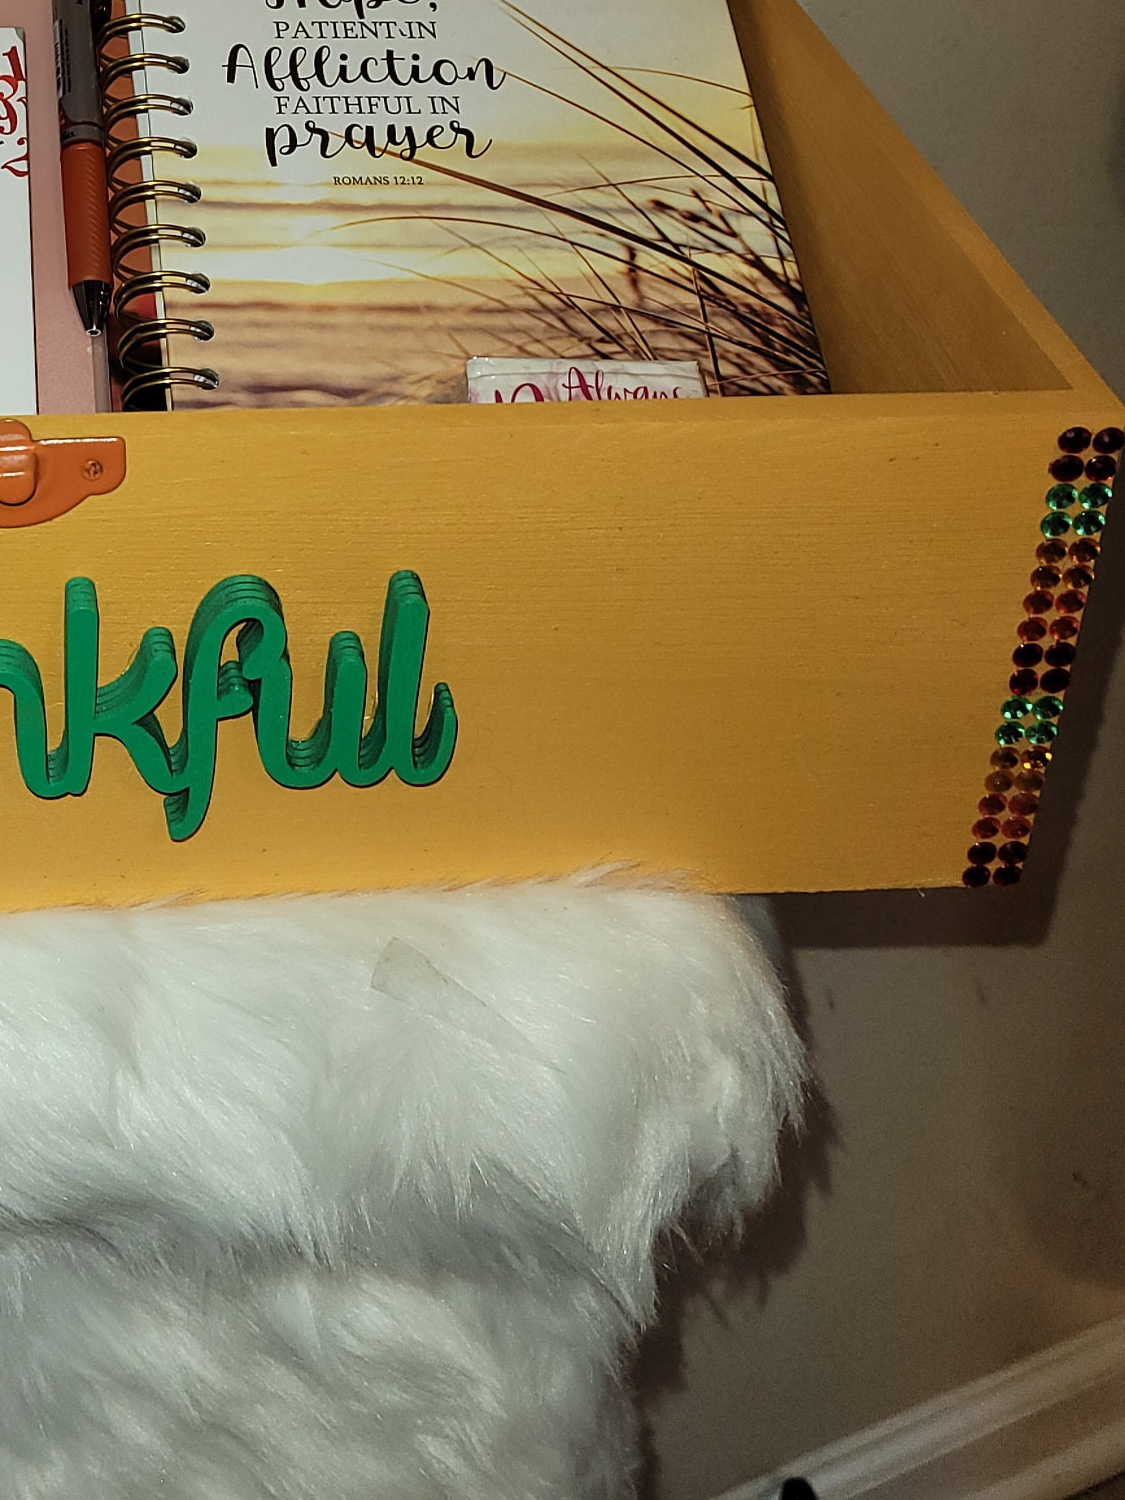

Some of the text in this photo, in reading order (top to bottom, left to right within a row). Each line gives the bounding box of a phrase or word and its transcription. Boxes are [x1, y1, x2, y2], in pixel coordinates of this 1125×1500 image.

[273, 20, 437, 39] PATIENT IN
[222, 43, 507, 92] Affliction
[273, 96, 461, 115] FAITHFUL IN
[265, 120, 493, 168] prayer
[333, 176, 424, 186] ROMANS 12:12
